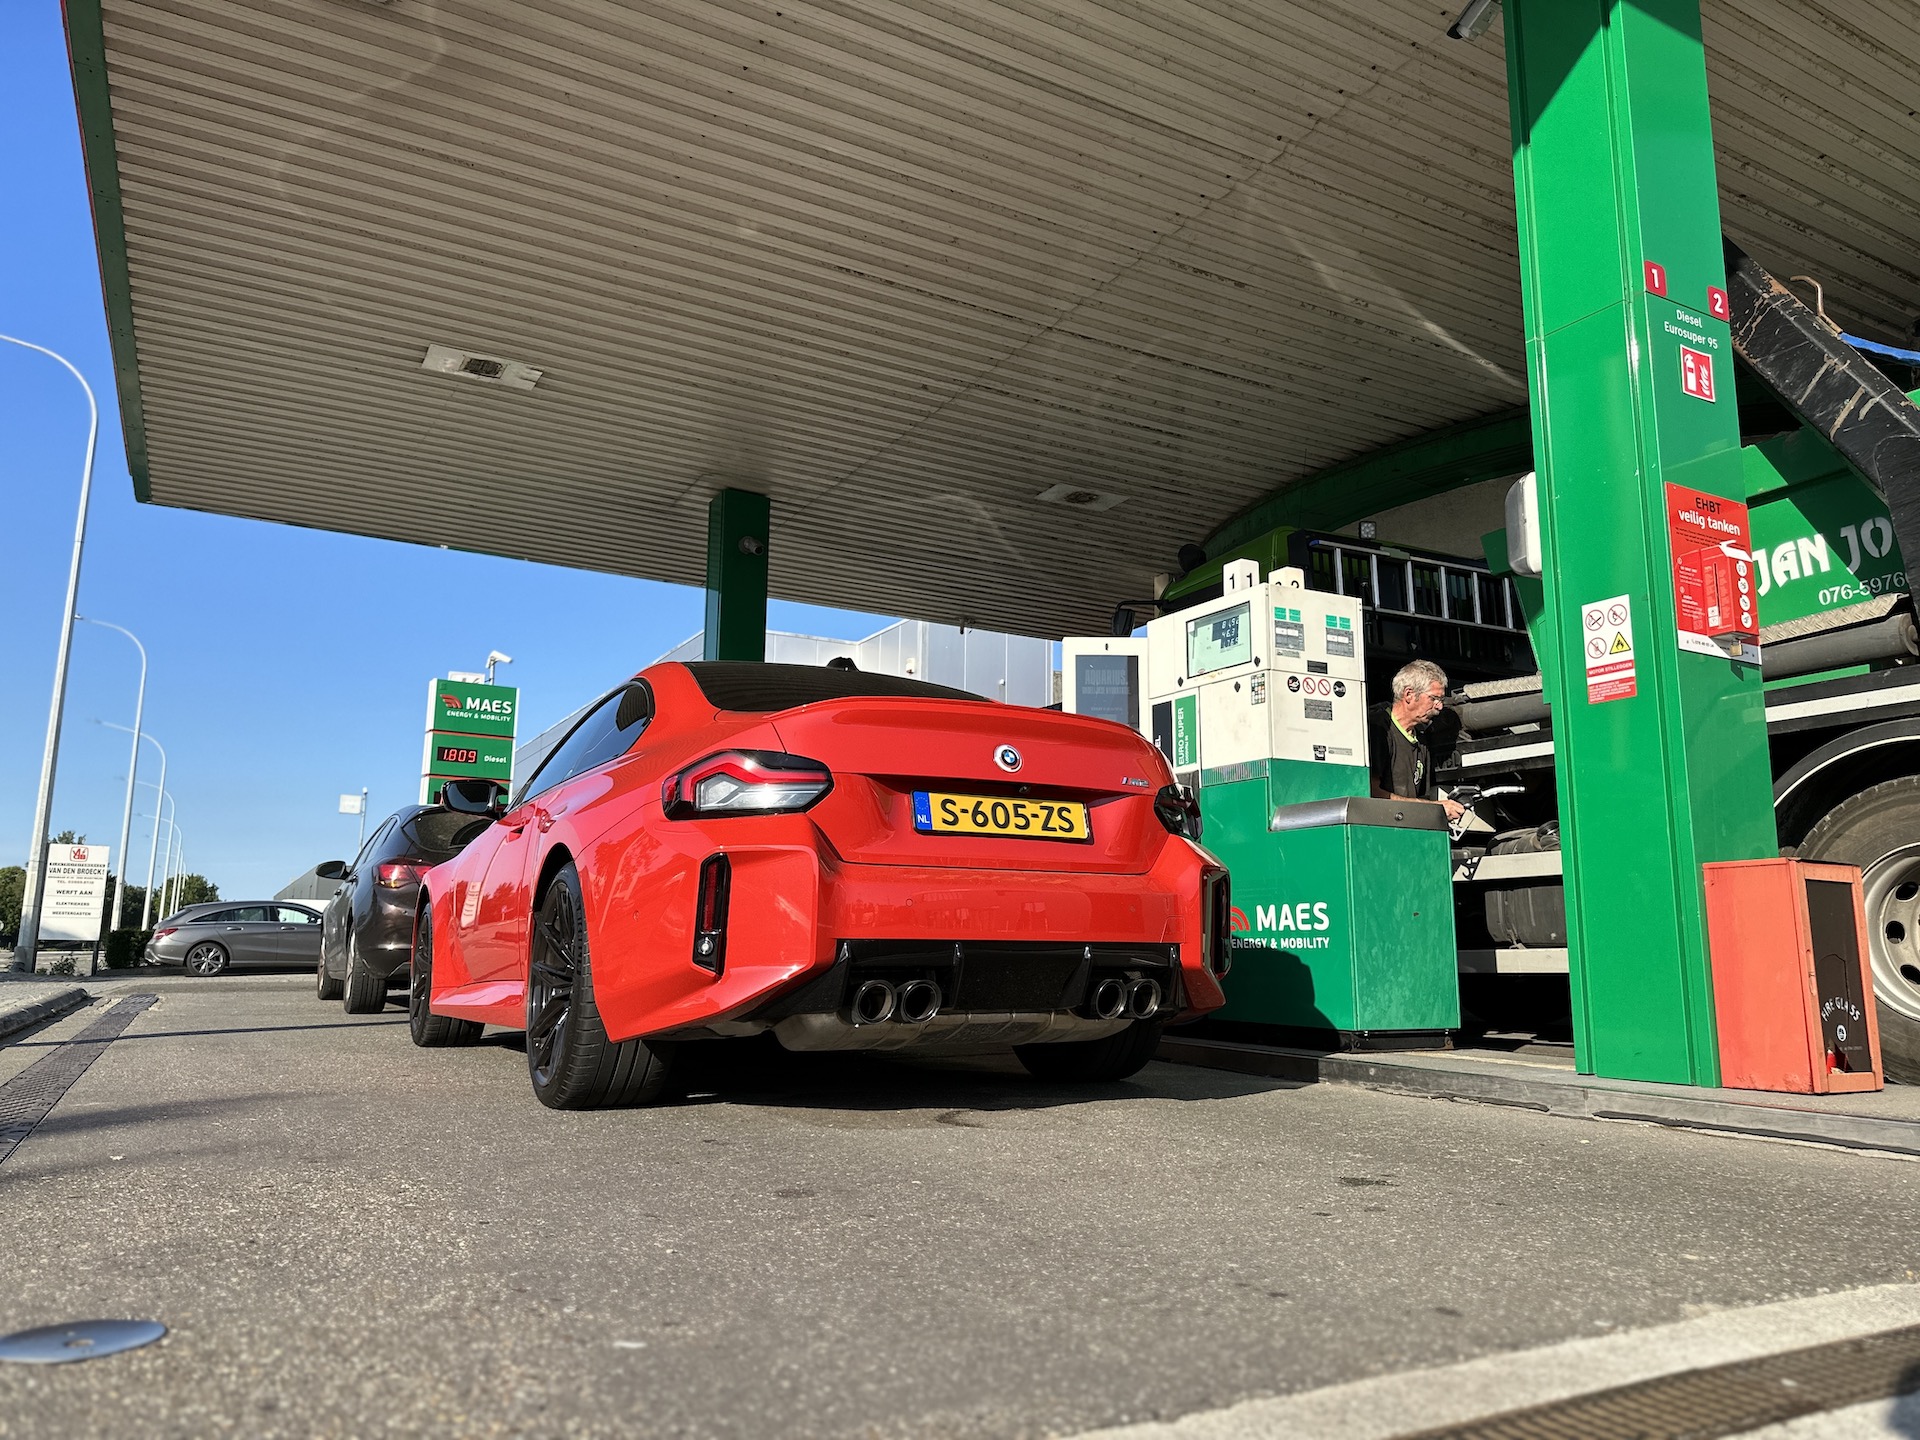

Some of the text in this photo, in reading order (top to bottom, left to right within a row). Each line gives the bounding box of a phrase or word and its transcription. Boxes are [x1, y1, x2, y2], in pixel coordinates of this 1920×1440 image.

[1651, 268, 1659, 288] 1
[1713, 293, 1724, 314] 2
[1676, 309, 1702, 328] Diesel
[1664, 321, 1718, 349] Eurosuper 95
[1695, 497, 1721, 514] EHBT
[1678, 510, 1740, 536] veilig tanken
[1752, 533, 1830, 597] JAN
[1229, 573, 1235, 589] 1
[1084, 669, 1129, 686] AQUARIUS.
[1589, 666, 1605, 675] MOTOR
[466, 697, 513, 714] MAES
[446, 710, 472, 719] ENERGY
[481, 713, 511, 722] MOBILITY
[443, 748, 507, 763] 1.809 Diesel
[917, 798, 1075, 833] NL S-605-ZS
[1256, 902, 1330, 931] MAES
[1231, 937, 1330, 949] ENERGY & MOBILITY
[1821, 996, 1861, 1022] FIRE GLASS
